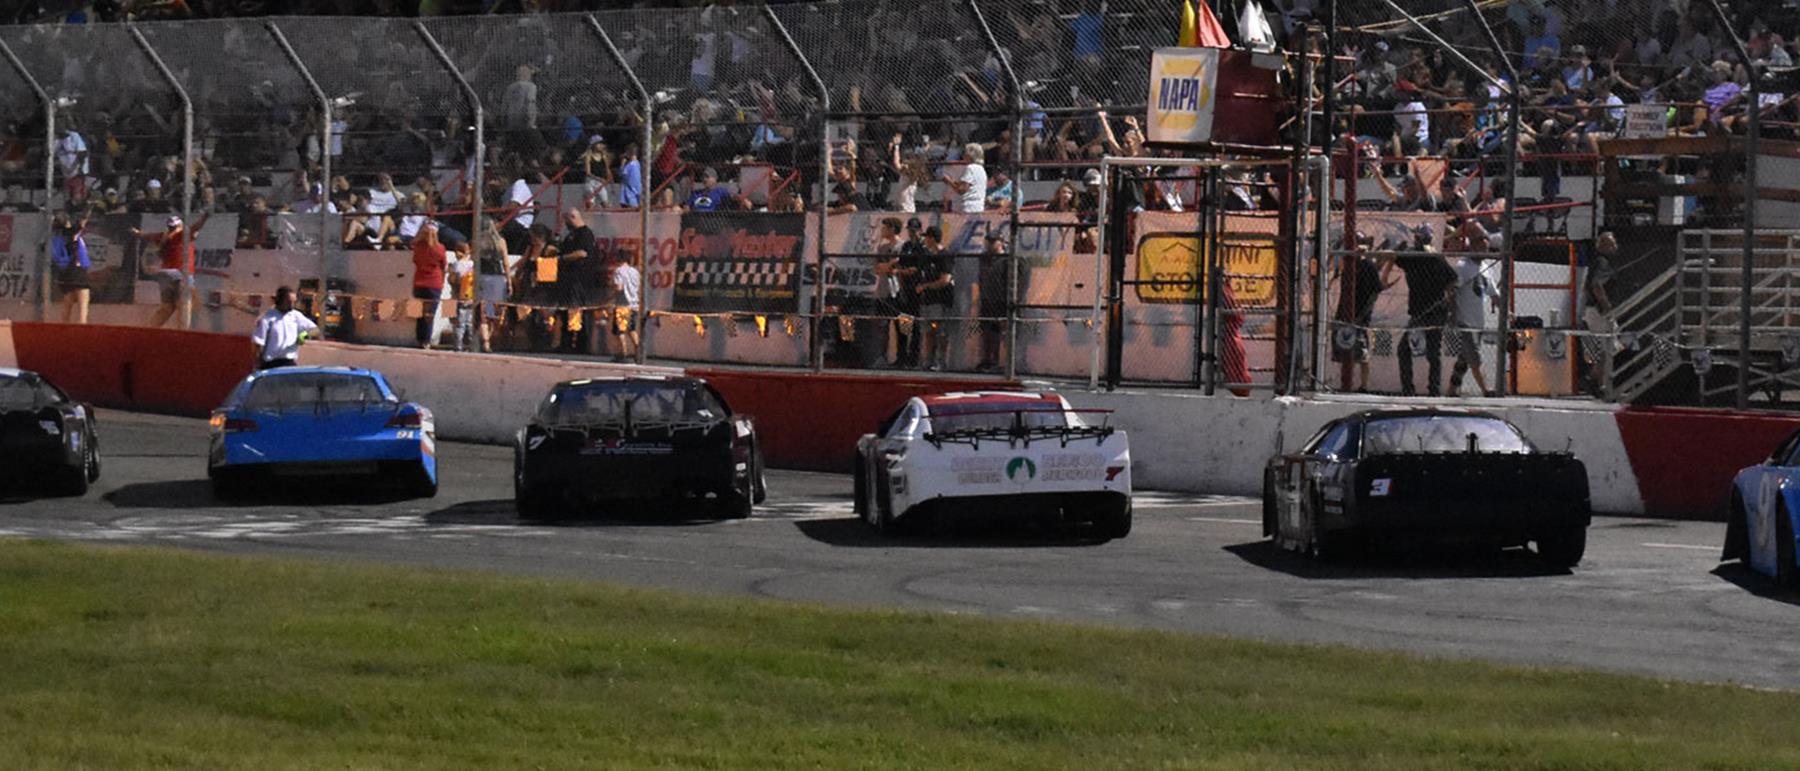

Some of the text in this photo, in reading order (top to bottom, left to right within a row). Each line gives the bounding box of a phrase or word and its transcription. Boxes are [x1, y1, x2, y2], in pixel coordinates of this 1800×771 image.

[1158, 78, 1200, 111] NAPA
[1105, 466, 1125, 481] 7
[1369, 478, 1393, 497] 3
